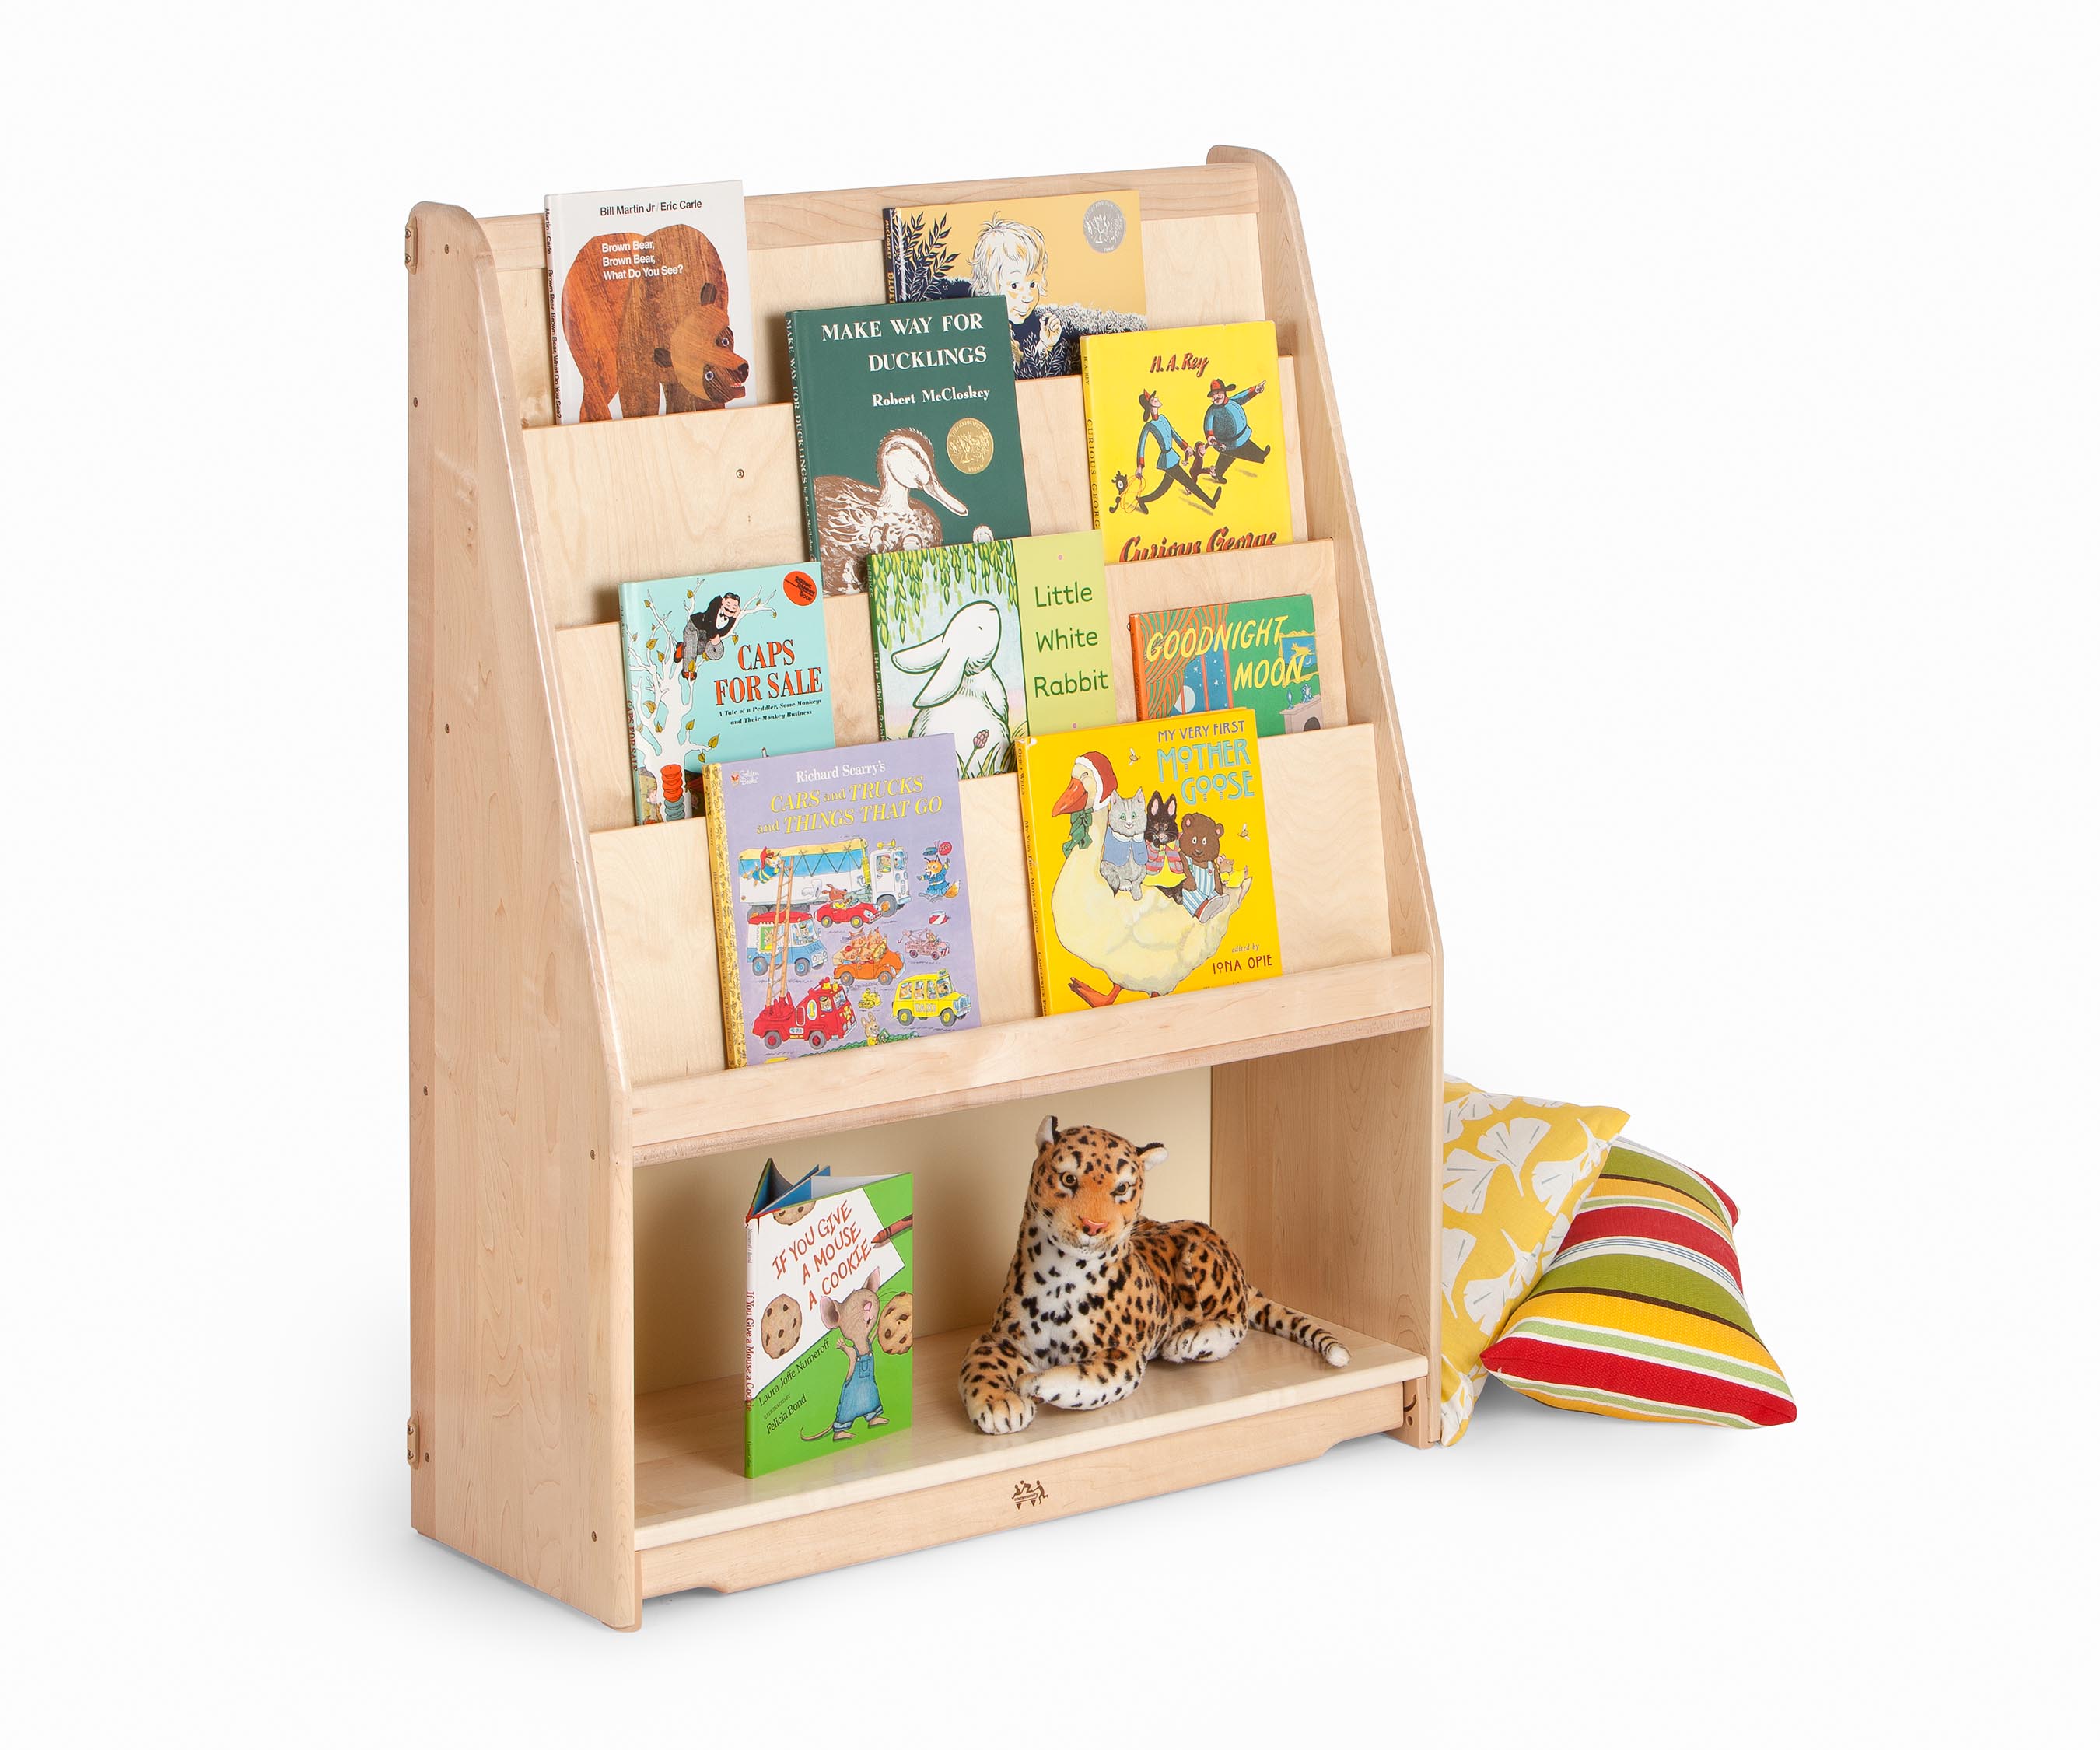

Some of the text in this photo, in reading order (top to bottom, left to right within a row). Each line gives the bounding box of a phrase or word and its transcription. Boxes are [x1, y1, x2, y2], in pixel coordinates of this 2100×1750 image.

[600, 205, 614, 216] Bill
[616, 204, 644, 215] Martin
[646, 203, 655, 213] Jr
[660, 201, 677, 212] Eric
[679, 199, 702, 210] Carle
[602, 240, 655, 254] Brown Bear,
[602, 254, 656, 267] Brown Bear,
[603, 264, 684, 281] What Do You See?
[821, 313, 984, 342] MAKE WAY FOR
[868, 345, 987, 372] DUCKLINGS
[1150, 352, 1210, 377] H. A. Rey
[554, 374, 560, 385] Do
[872, 385, 990, 407] Robert McCloskey
[795, 415, 807, 485] DUCKLINGS
[1087, 419, 1097, 475] CURIOUS
[1092, 483, 1101, 527] GEORG
[1034, 581, 1094, 608] Little
[1035, 628, 1099, 653] White
[1146, 615, 1290, 663] GOODNIGHT
[737, 639, 795, 672] CAPS
[713, 667, 824, 706] FOR SALE
[1034, 669, 1109, 698] Rabbit
[1234, 654, 1306, 691] MOON
[1158, 720, 1246, 743] MY VERY FIRST
[796, 760, 885, 785] Richard Scarry's
[1157, 739, 1251, 782] MOTHER
[770, 775, 924, 814] CARS and TRUCKS
[1181, 770, 1255, 805] GOOSE
[756, 794, 943, 835] and THINGS THAT GO
[1232, 943, 1259, 953] edited by
[1213, 954, 1272, 975] IONA OPIE
[914, 1003, 936, 1013] TAXI
[772, 1199, 852, 1280] IF YOU GIVE
[802, 1221, 862, 1285] A MOUSE
[809, 1237, 872, 1311] A COOKIE
[746, 1290, 754, 1299] If
[746, 1300, 754, 1316] You
[746, 1318, 754, 1337] Give
[746, 1346, 754, 1374] Mouse
[758, 1336, 830, 1407] Laura Joffe Numeroff
[745, 1382, 754, 1412] Cookie
[765, 1393, 807, 1434] Felicia Bond
